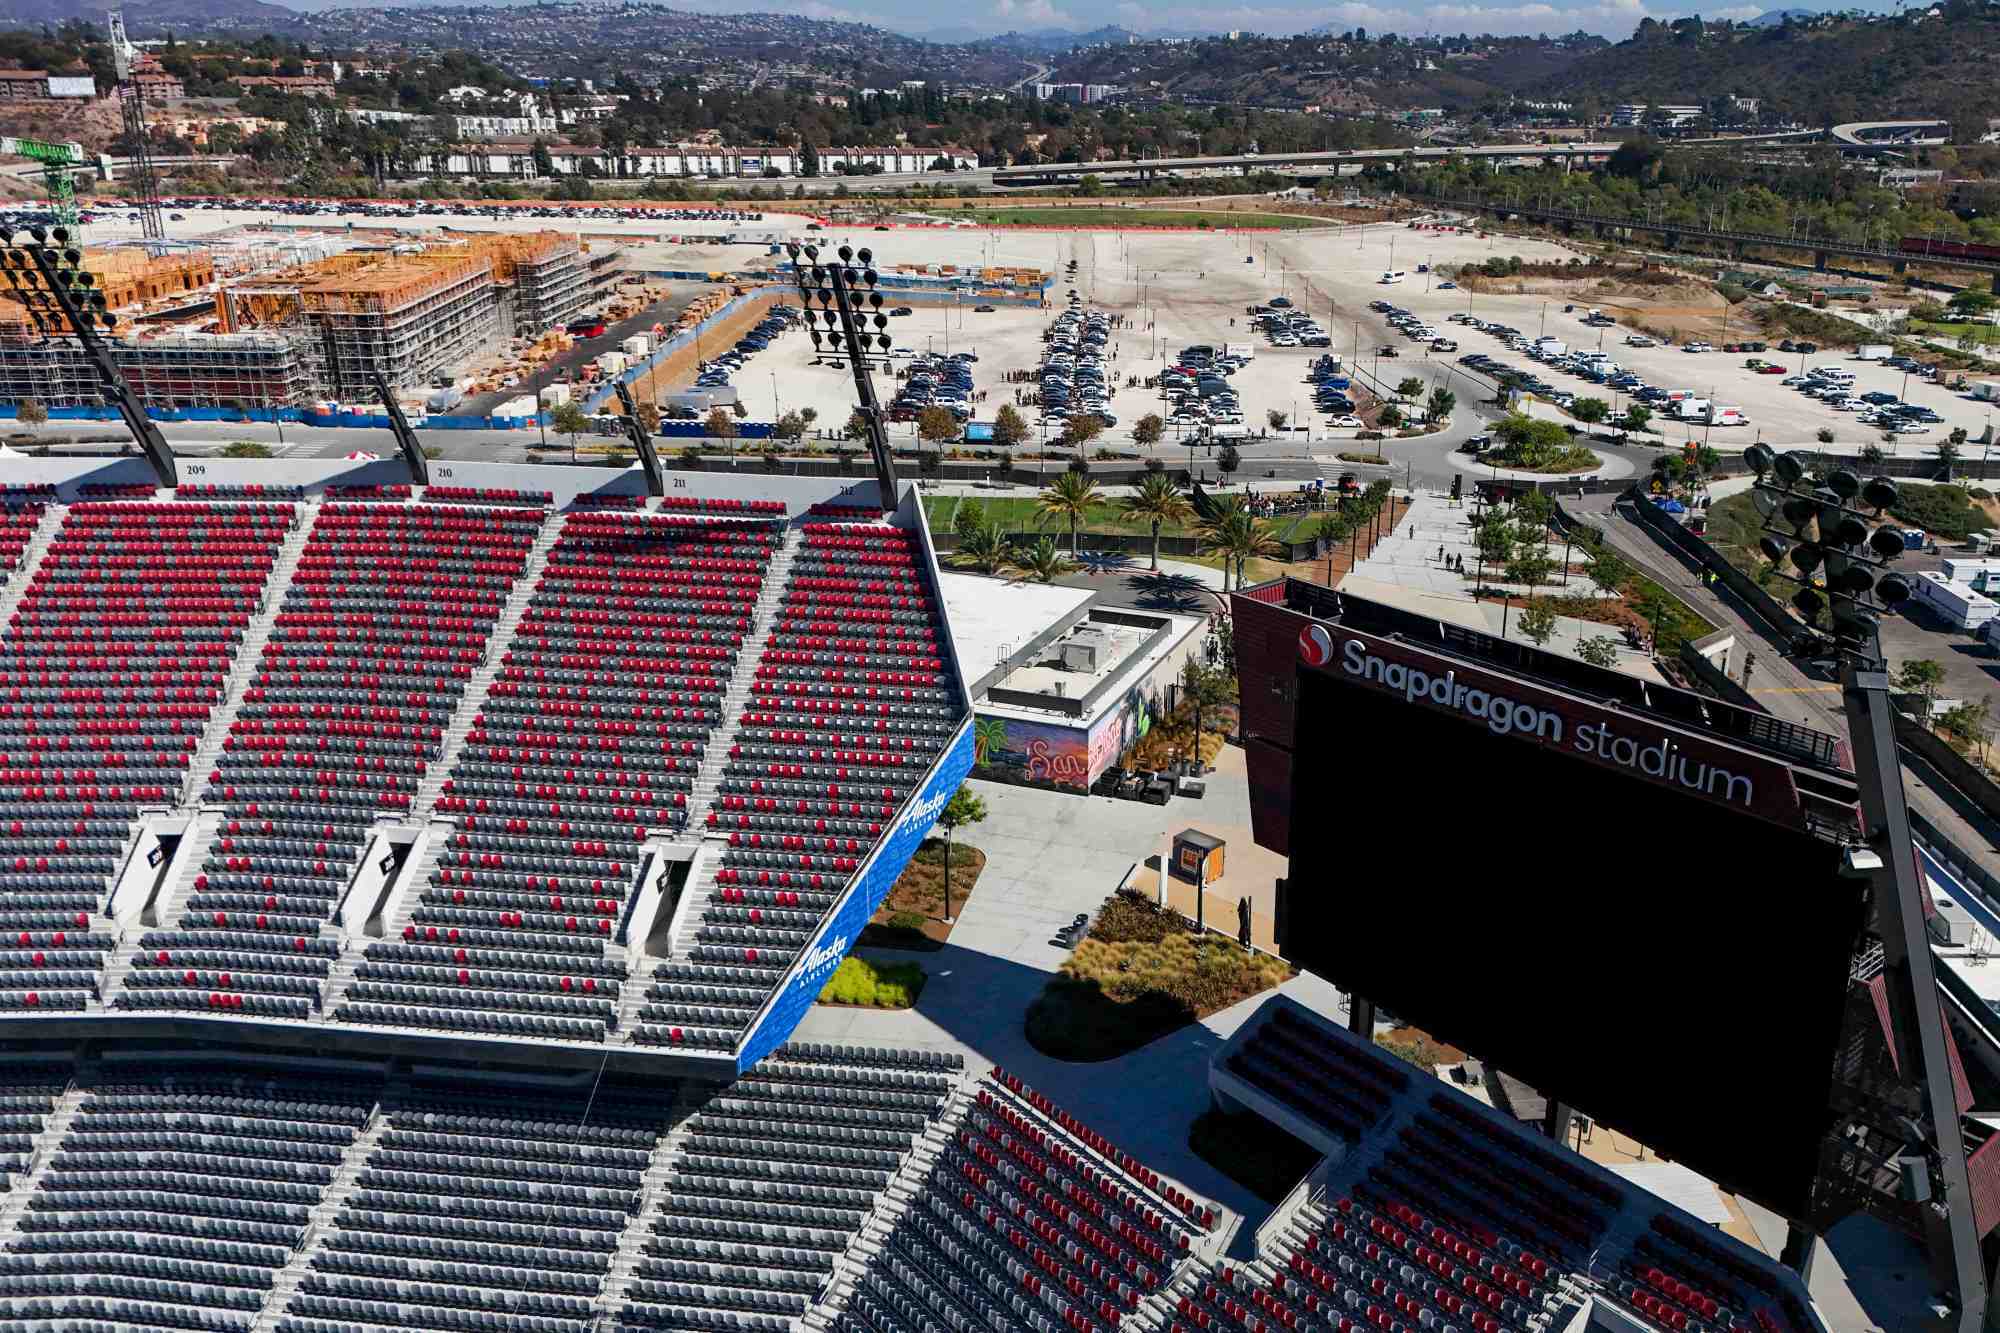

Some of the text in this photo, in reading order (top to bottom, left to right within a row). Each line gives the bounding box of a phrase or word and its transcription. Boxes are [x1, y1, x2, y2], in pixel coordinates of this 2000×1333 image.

[186, 465, 206, 475] 209
[437, 467, 453, 478] 210
[673, 478, 686, 488] 211
[1342, 638, 1753, 806] Snapdragon stadium
[1030, 740, 1086, 779] San
[902, 789, 947, 828] Alaska
[796, 935, 848, 981] Alaska
